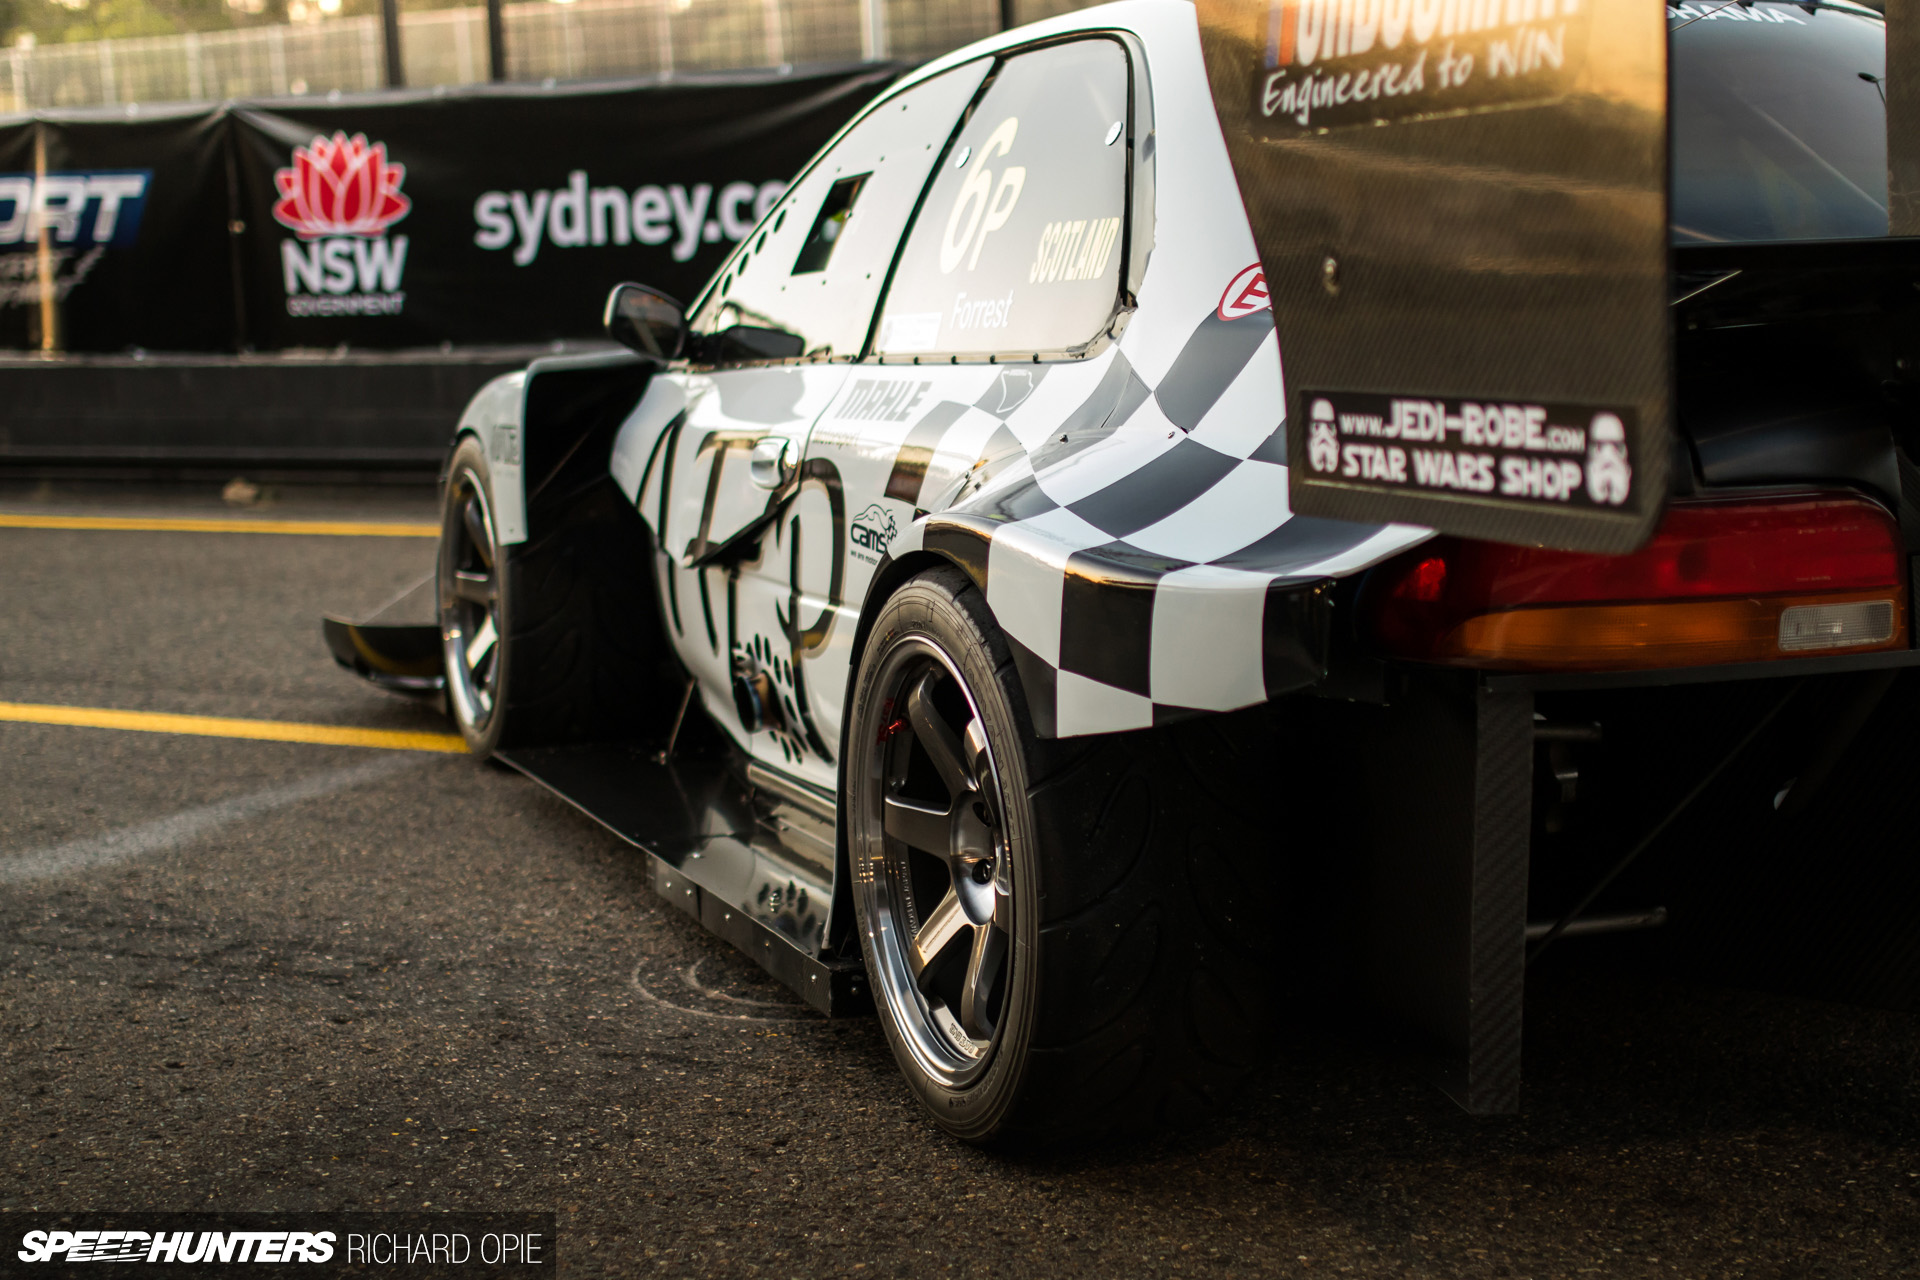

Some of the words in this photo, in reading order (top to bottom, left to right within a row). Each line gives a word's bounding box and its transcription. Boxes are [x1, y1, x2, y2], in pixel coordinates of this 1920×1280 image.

[1668, 3, 1807, 26] HAMA
[1262, 51, 1427, 125] Engineered
[1438, 40, 1474, 89] to
[1487, 22, 1566, 79] WIN
[280, 234, 409, 294] NSW
[1029, 217, 1121, 285] SCOTLAND
[951, 289, 1014, 331] Forrest
[834, 378, 933, 422] MAHLE
[1341, 443, 1408, 484] STAR
[1411, 448, 1495, 493] WARS
[1500, 455, 1583, 501] SHOP
